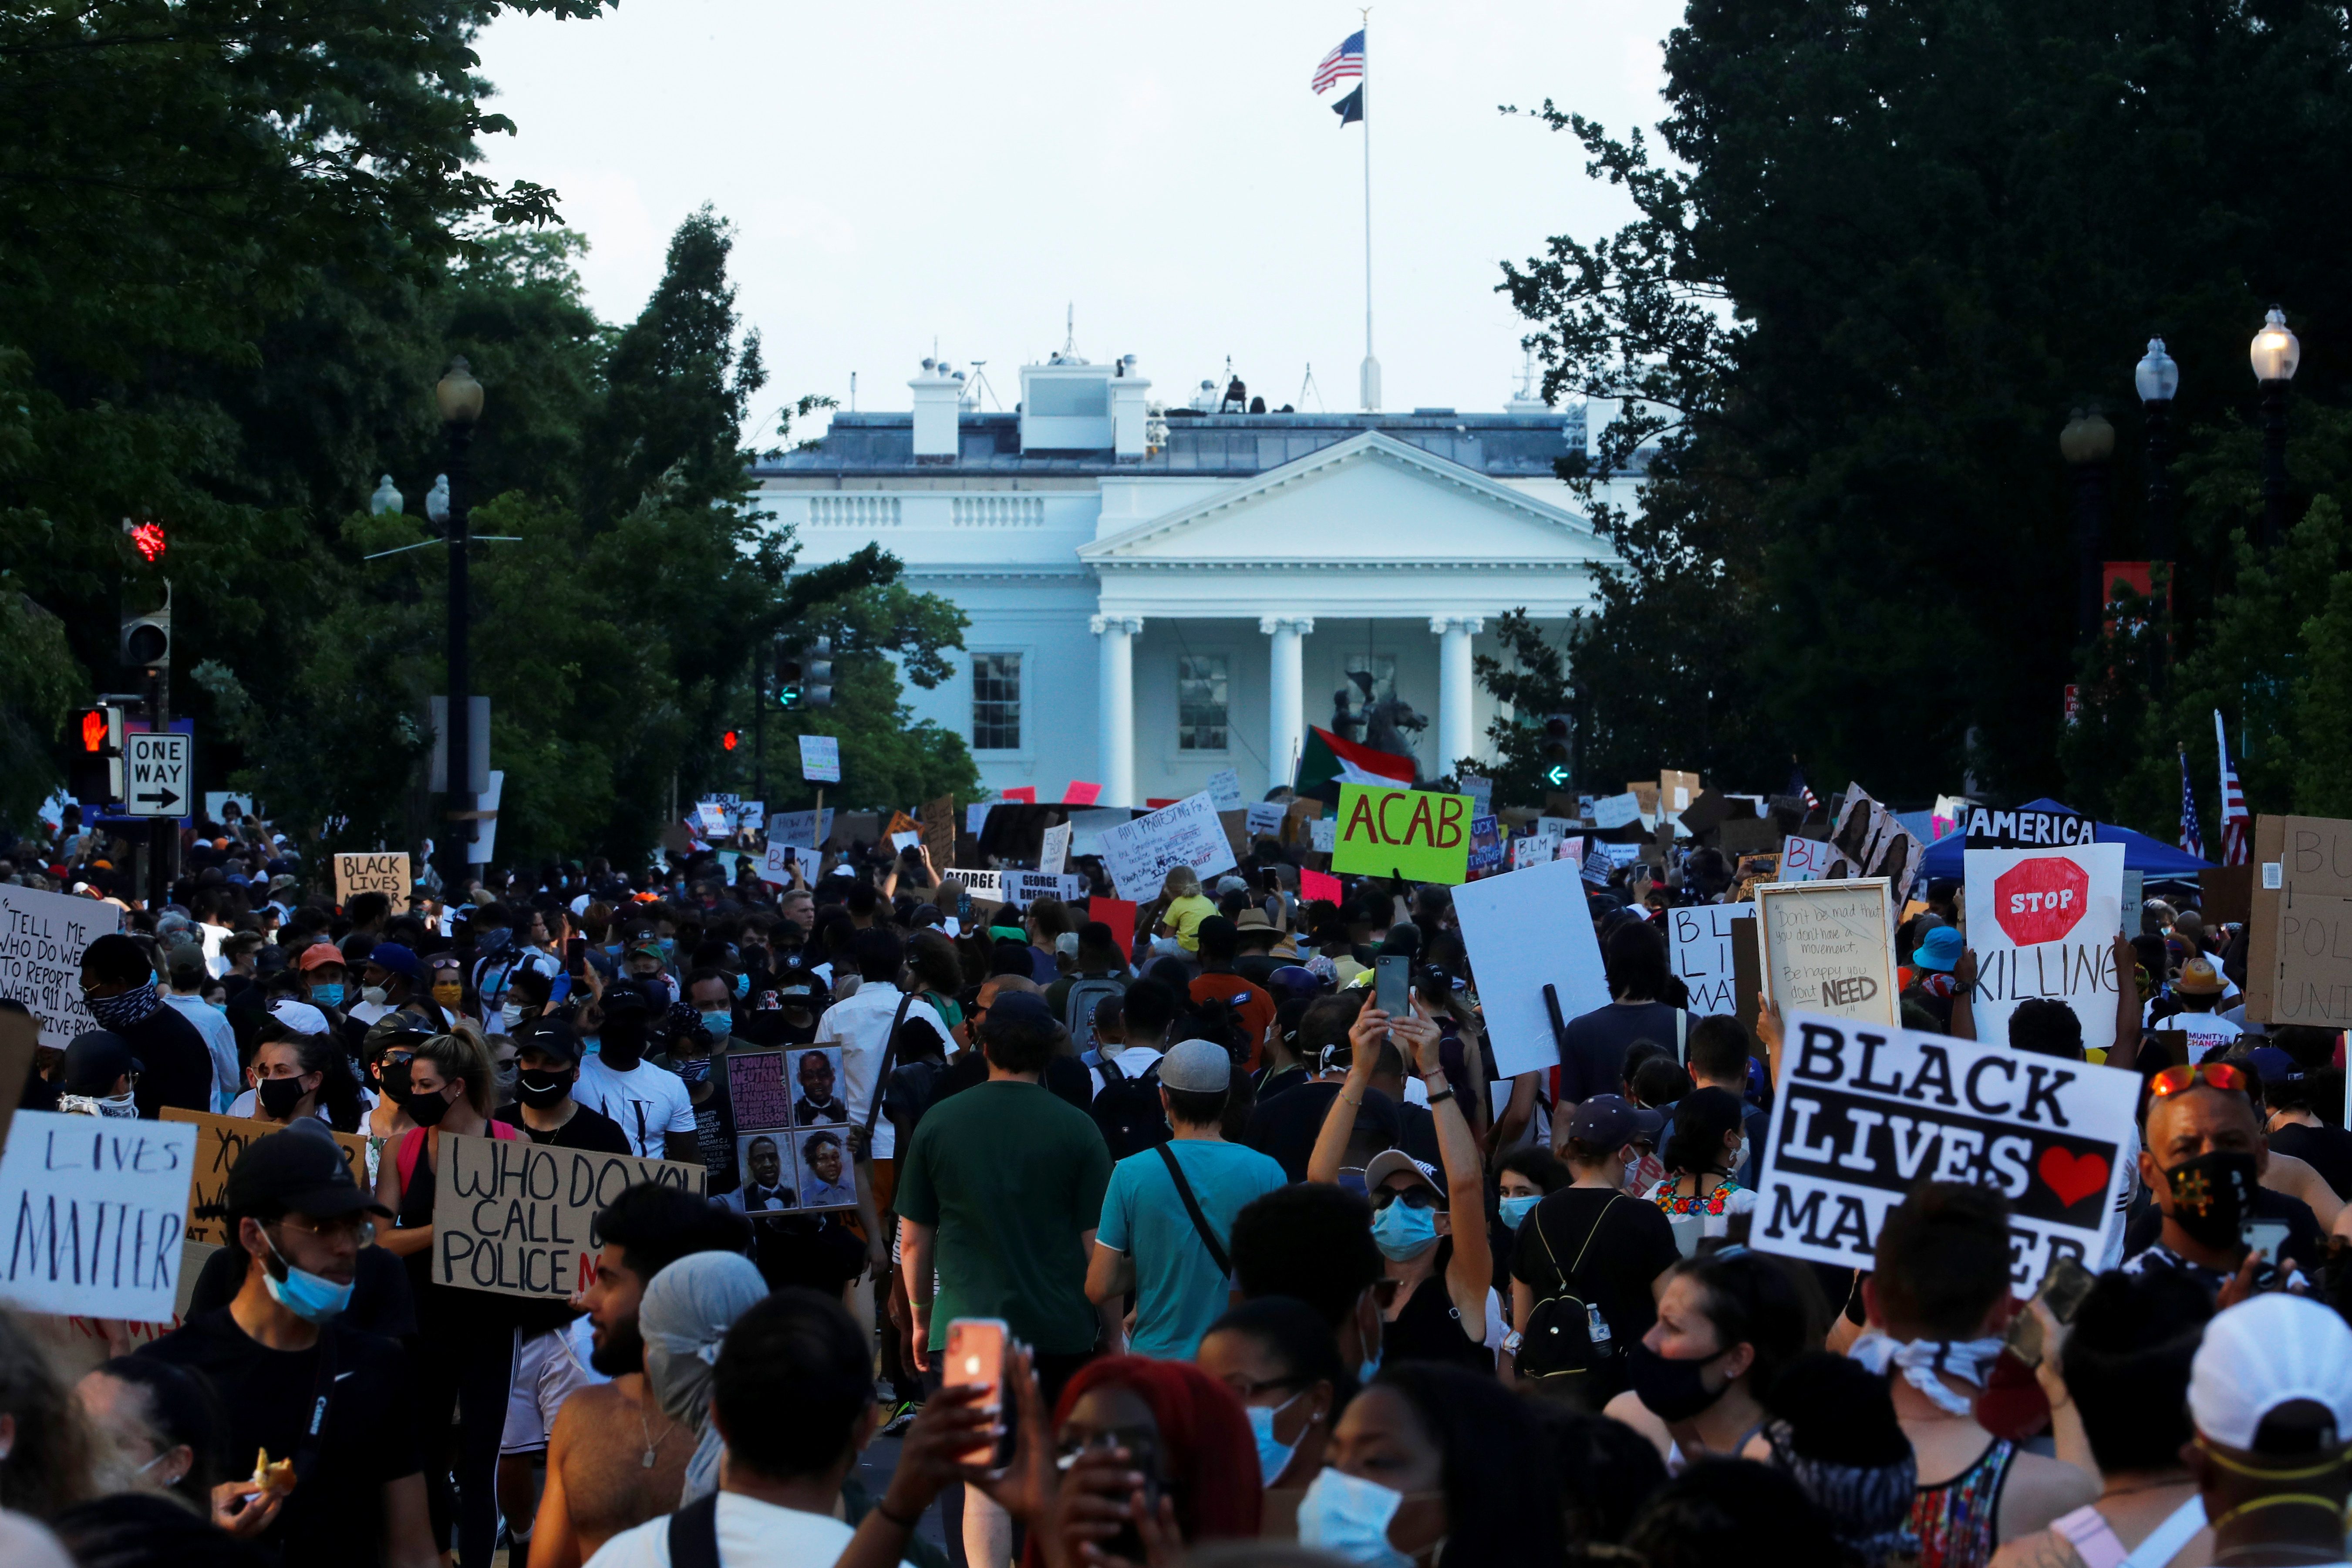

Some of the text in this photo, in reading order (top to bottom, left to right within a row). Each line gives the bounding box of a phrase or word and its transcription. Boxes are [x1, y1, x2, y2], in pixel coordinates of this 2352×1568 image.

[137, 741, 181, 760] ONE
[135, 764, 182, 783] WAY
[1343, 792, 1463, 849] ACAB
[1472, 820, 1493, 835] UCK
[1966, 808, 2094, 845] AMERICA
[1519, 837, 1547, 855] BLM
[1787, 838, 1820, 872] BL
[343, 856, 400, 877] BLACK
[768, 849, 809, 877] BM
[350, 876, 400, 891] LIVES
[1023, 874, 1058, 887] GEORGE
[1815, 908, 1829, 921] be
[1832, 904, 1856, 918] mad
[1860, 903, 1881, 918] that
[2010, 889, 2073, 914] STOP
[0, 933, 31, 958] WHO
[38, 940, 57, 962] DO
[1775, 928, 1853, 945] you don't have a
[1801, 941, 1859, 955] movement,
[0, 956, 74, 989] TO REPORT
[1681, 948, 1724, 978] LI
[1783, 966, 1867, 982] Be happy you
[1972, 943, 2120, 1004] KILLING
[0, 978, 39, 1006] WHEN
[43, 986, 59, 1011] 911
[1687, 978, 1735, 1012] MA
[1821, 976, 1878, 1008] NEED
[729, 1055, 782, 1071] IF YOU ARE
[731, 1067, 784, 1086] NEUTRAL
[1792, 1022, 2076, 1127] BLACK
[742, 1090, 786, 1102] INJUSTICE
[698, 1127, 720, 1135] GARVEY
[736, 1112, 787, 1125] OPPRESSOR
[45, 1130, 183, 1173] LIVES
[1782, 1096, 2034, 1200] LIVES
[453, 1136, 559, 1200] WHO
[569, 1153, 631, 1209] DO
[1413, 1160, 1438, 1176] ORK
[472, 1198, 574, 1244] CALL
[1763, 1184, 2086, 1286] MAER
[9, 1188, 182, 1291] MATTER
[443, 1230, 572, 1295] POLICE
